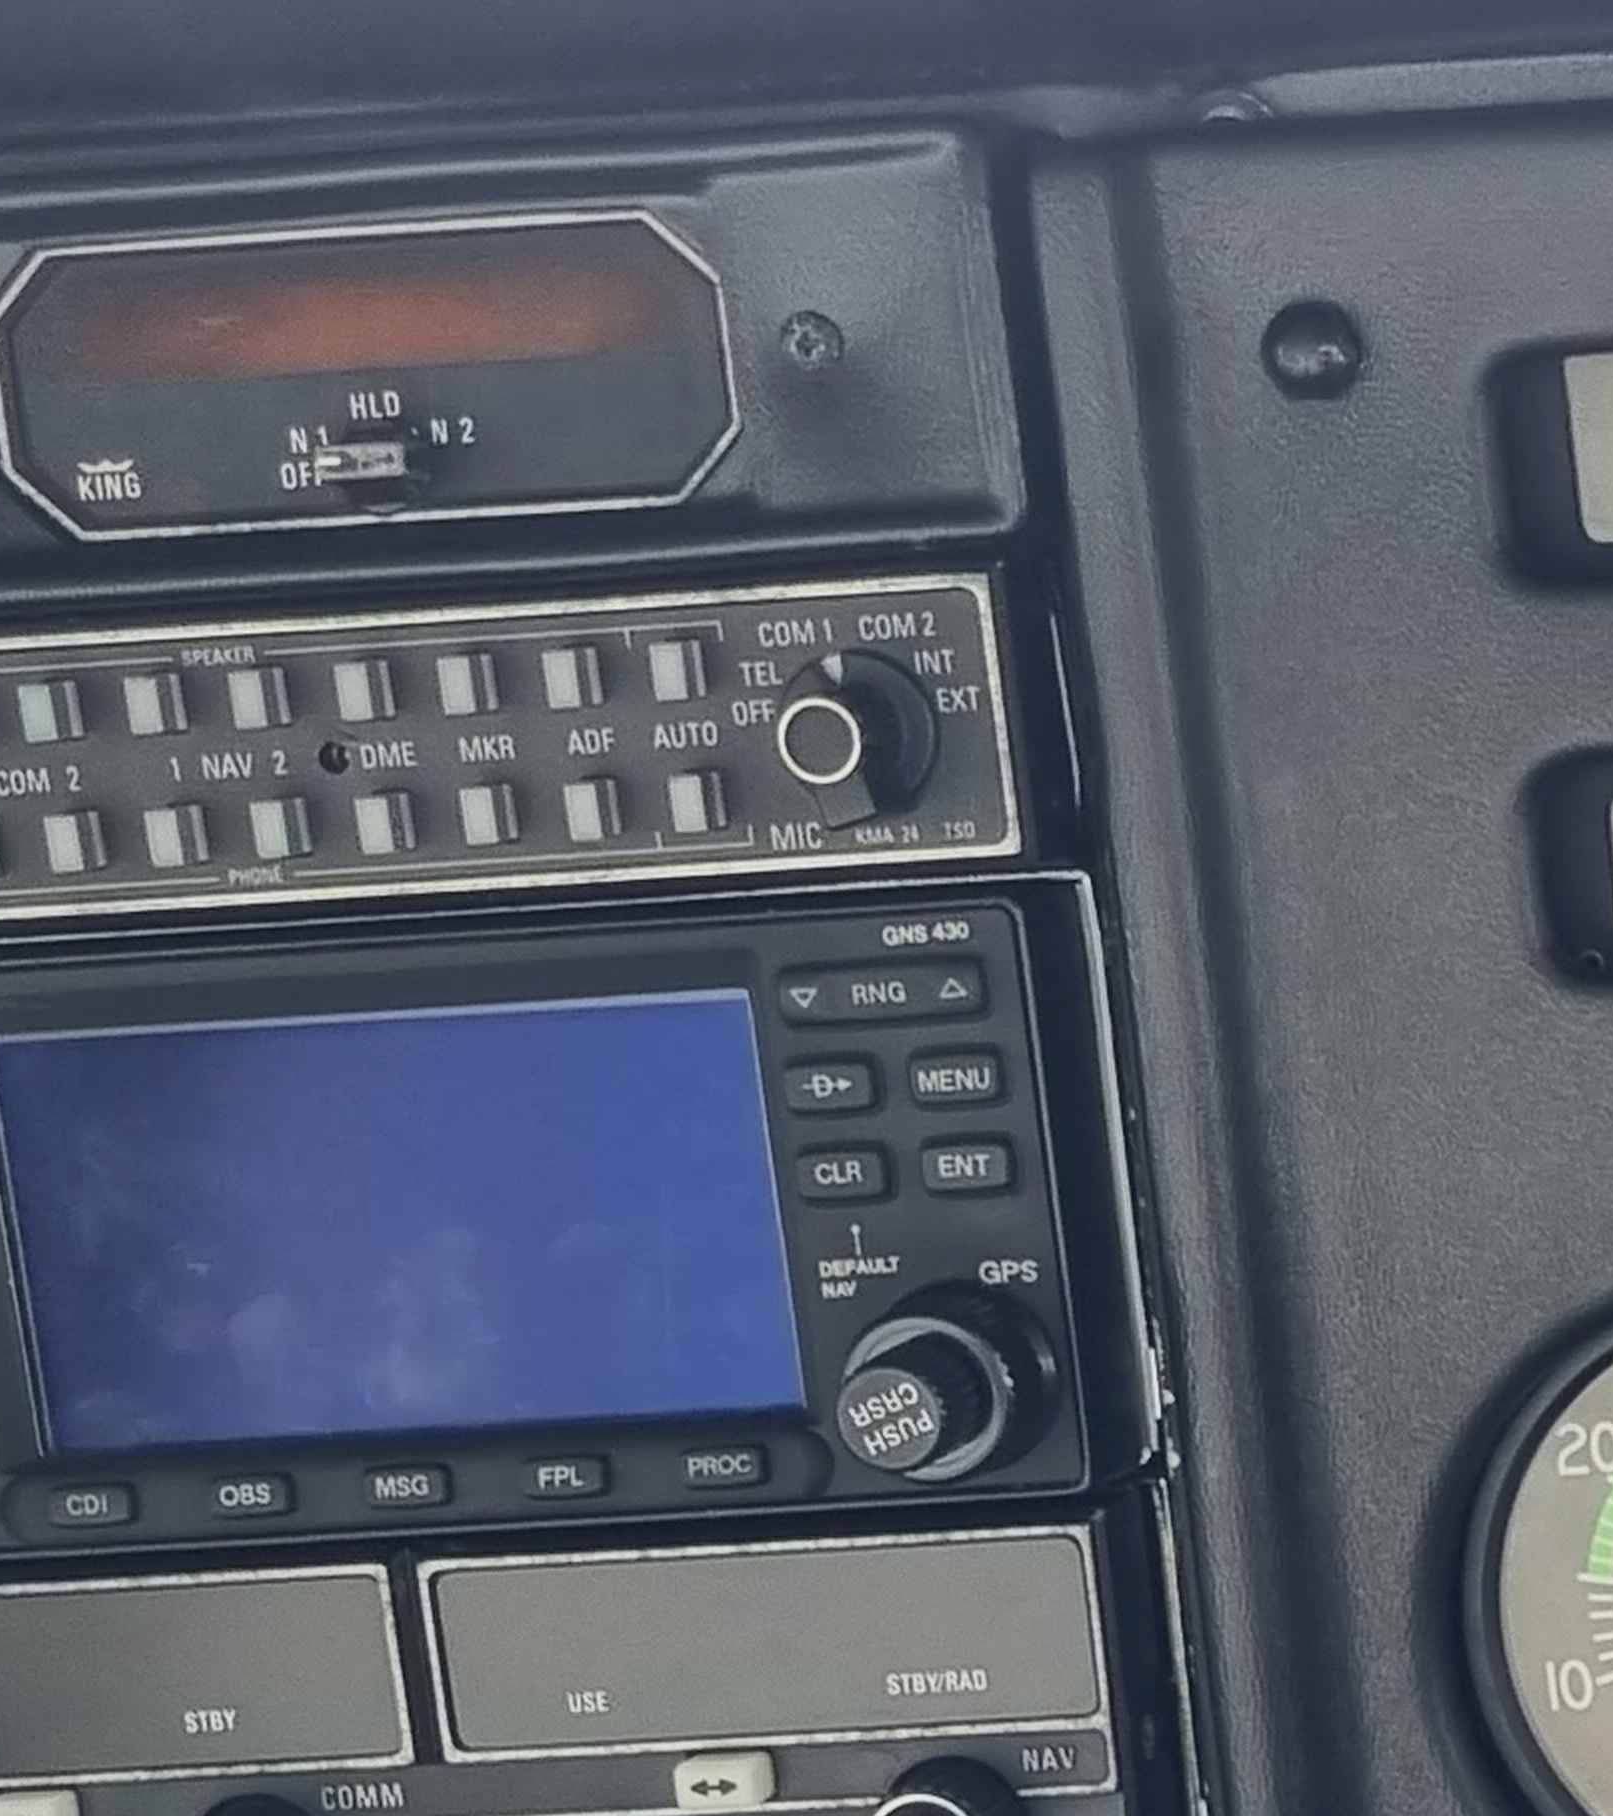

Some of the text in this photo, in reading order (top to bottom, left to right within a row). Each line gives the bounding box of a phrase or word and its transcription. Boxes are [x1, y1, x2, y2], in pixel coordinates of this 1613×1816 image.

[78, 474, 141, 501] KING
[759, 620, 814, 648] COM
[859, 613, 914, 640] COM
[915, 650, 954, 675] INT
[937, 687, 980, 712] EXT
[732, 701, 774, 727] OFF
[568, 729, 614, 755] ADF
[654, 722, 718, 750] AUTO
[360, 742, 415, 770] DME
[460, 736, 514, 762] MKR
[203, 753, 253, 780] NAV
[772, 822, 821, 851] MIC
[883, 921, 969, 946] GNS 430
[852, 981, 905, 1006] RNG
[918, 1068, 991, 1093] MENU
[814, 1162, 862, 1185] CLR
[938, 1155, 991, 1179] ENT
[978, 1260, 1038, 1285] GPS
[539, 1466, 583, 1489] FPL
[688, 1453, 751, 1478] PROC
[218, 1482, 270, 1508] OBS
[375, 1473, 429, 1498] MSG
[66, 1492, 108, 1517] CDI
[886, 1669, 988, 1695] STBY/RAD
[1545, 1659, 1593, 1711] 10
[185, 1710, 236, 1734] STBY
[1021, 1747, 1076, 1771] NAV
[321, 1783, 404, 1811] COMM
